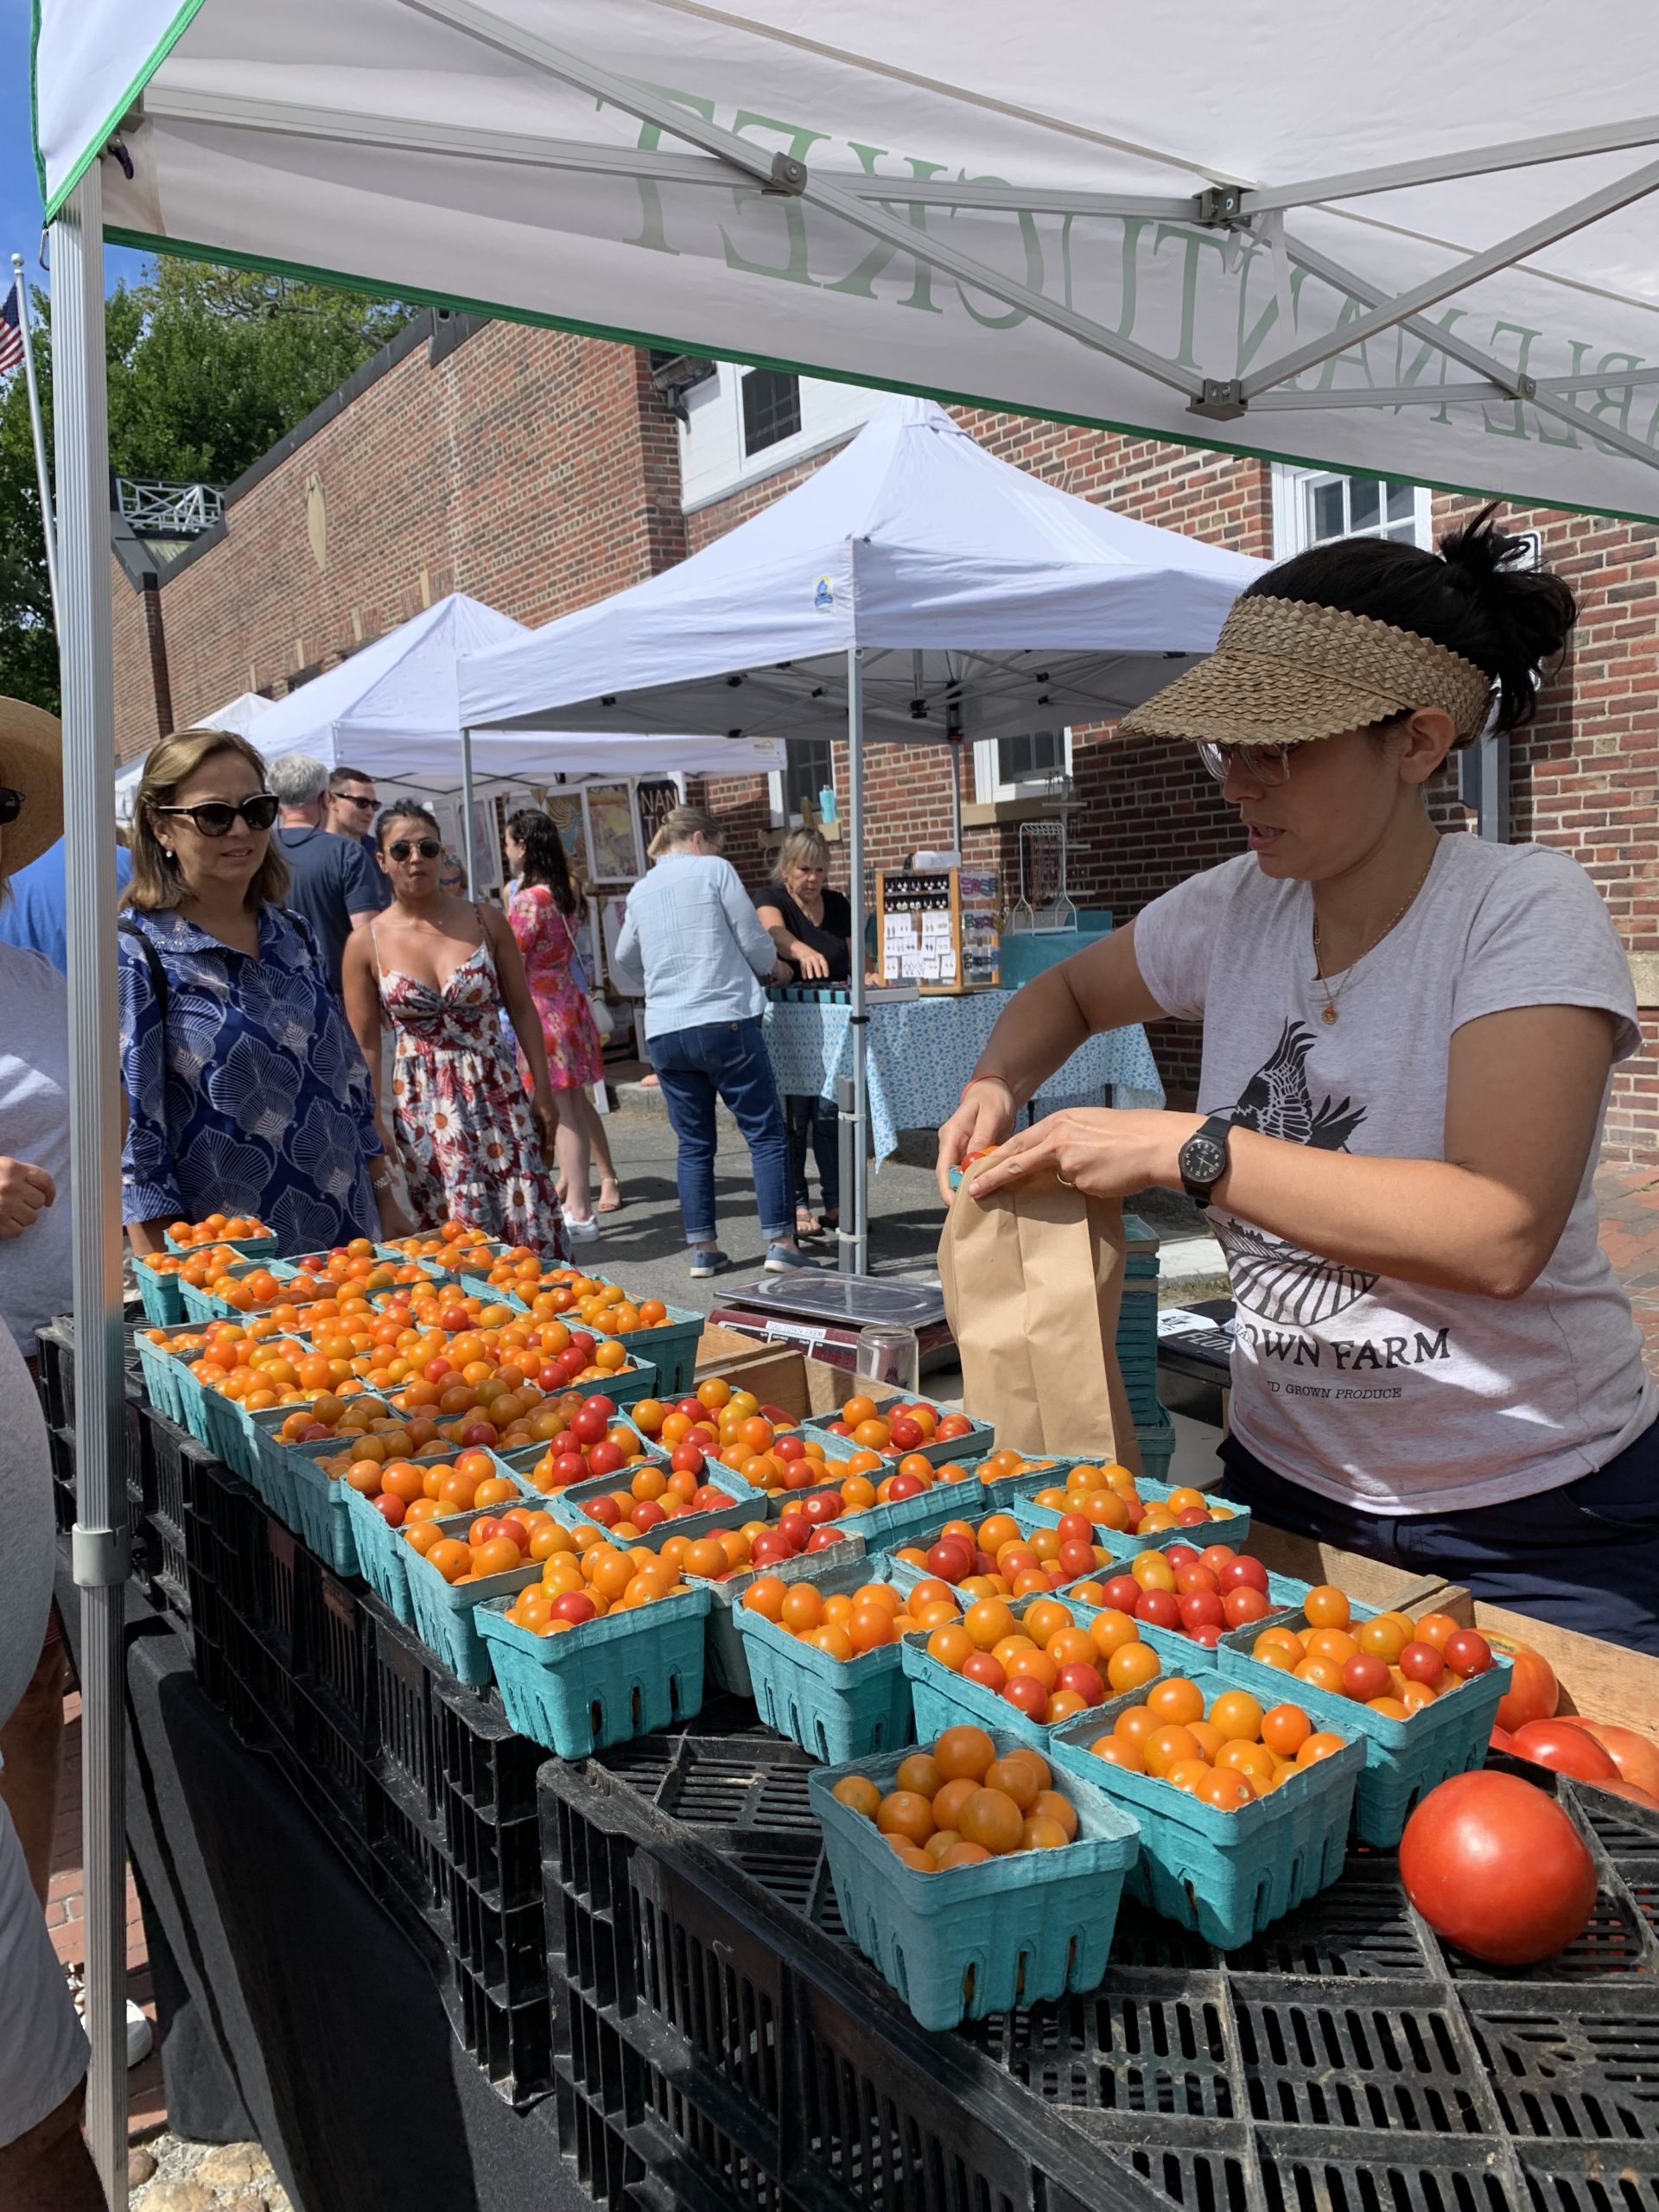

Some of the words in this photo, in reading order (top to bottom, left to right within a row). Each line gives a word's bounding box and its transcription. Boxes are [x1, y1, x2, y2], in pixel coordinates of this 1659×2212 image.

[1331, 1327, 1451, 1370] FARM
[1285, 1383, 1332, 1399] GROWN
[1334, 1388, 1402, 1400] PRODUCE
